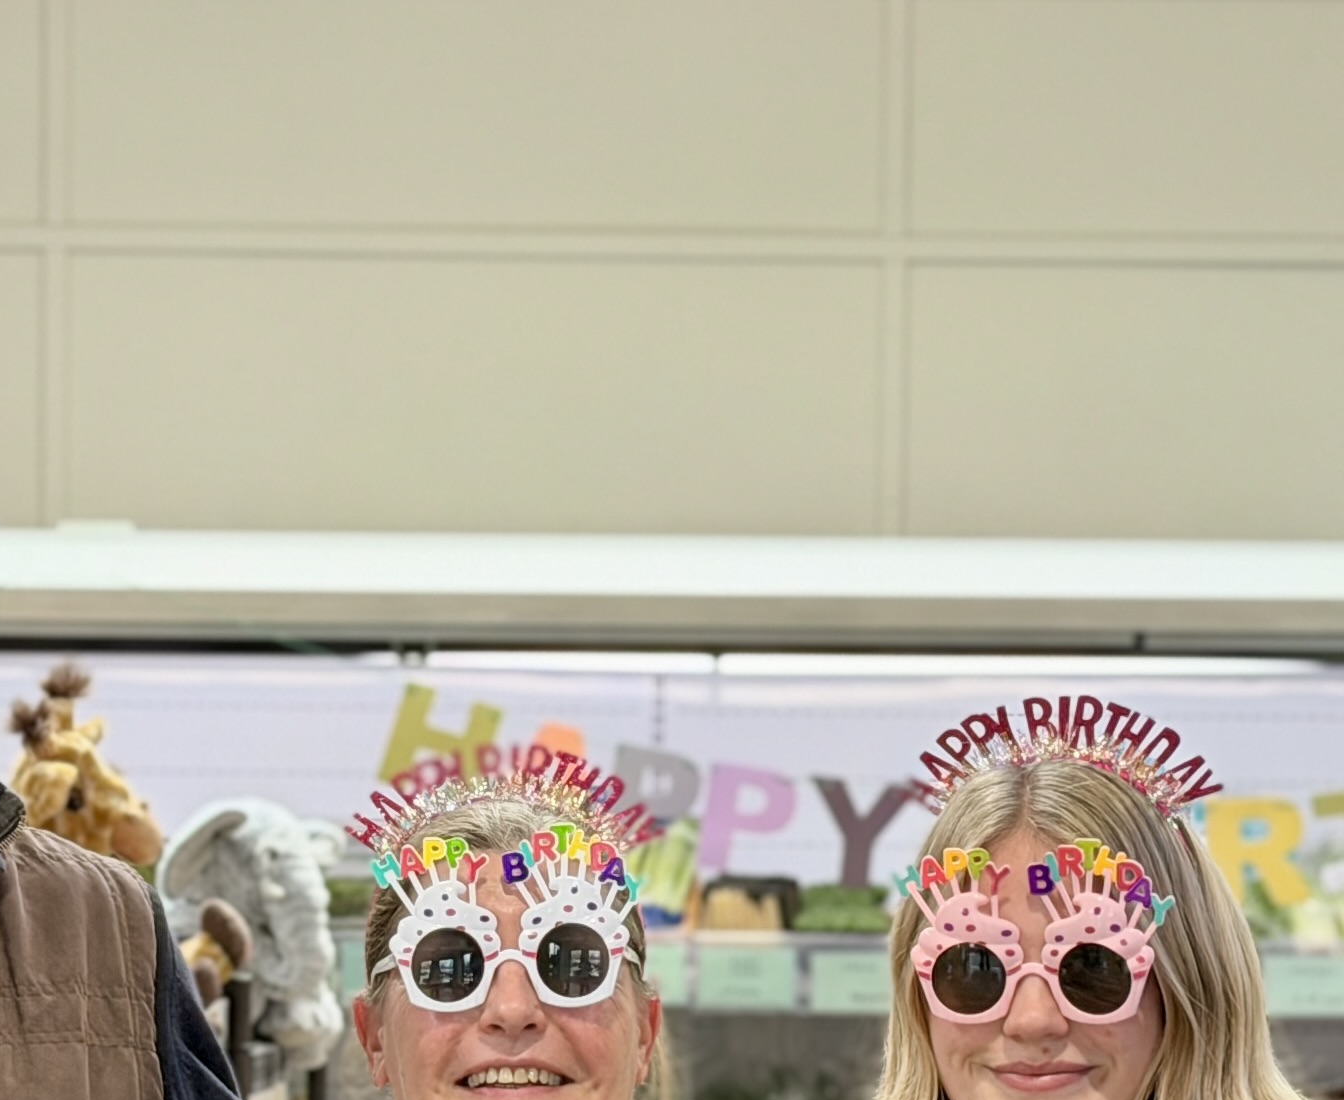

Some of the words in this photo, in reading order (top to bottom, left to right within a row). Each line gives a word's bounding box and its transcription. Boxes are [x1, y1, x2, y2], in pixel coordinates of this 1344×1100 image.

[1022, 695, 1224, 805] BIRTHDAY
[370, 836, 490, 890] HAPPY
[501, 821, 641, 904] BIRTHDAY
[892, 846, 1011, 898] HAPPY
[1027, 837, 1176, 927] BIRTHDAY
